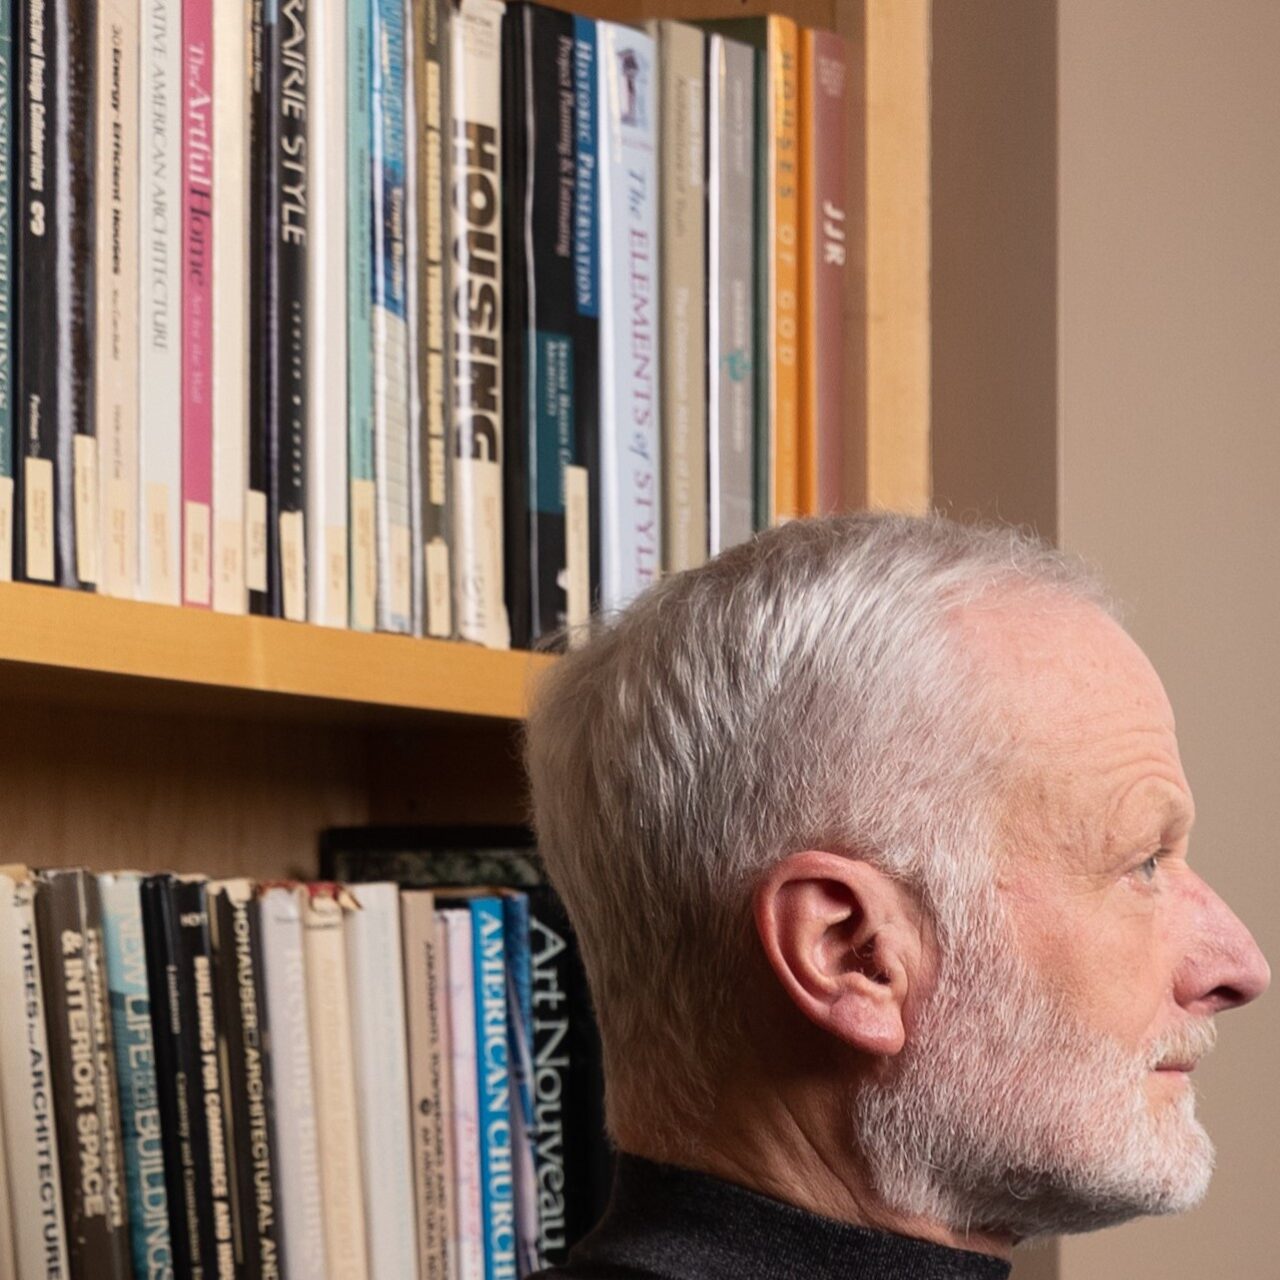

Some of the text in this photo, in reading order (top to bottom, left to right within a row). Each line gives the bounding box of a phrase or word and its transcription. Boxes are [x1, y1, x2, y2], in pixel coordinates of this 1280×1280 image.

[27, 58, 45, 101] Design
[556, 35, 572, 86] Project
[30, 103, 46, 191] Collaborators
[152, 66, 169, 178] AMERICAN
[557, 89, 572, 155] Planning
[188, 187, 212, 287] Home
[281, 133, 307, 246] STYLE
[557, 176, 573, 257] Estimating
[629, 168, 647, 218] The
[822, 201, 846, 267] JJR
[112, 208, 122, 275] Houses
[152, 184, 170, 352] ARCHITECTURE
[453, 119, 498, 464] HOUSING
[630, 228, 653, 428] ELEMENTS
[628, 432, 652, 461] of
[634, 470, 656, 586] STYLE
[22, 926, 39, 1019] TREES
[194, 955, 217, 1052] BUILDINGS
[478, 909, 509, 1111] AMERICAN
[62, 930, 106, 1217] & INTERIOR SPACE
[126, 994, 155, 1069] LIFE
[202, 1055, 220, 1091] FOR
[530, 914, 571, 1250] Art Nouveau
[204, 1092, 228, 1197] COMMERCE
[243, 1046, 280, 1229] ARCHITECTURAL
[211, 1201, 231, 1240] AND
